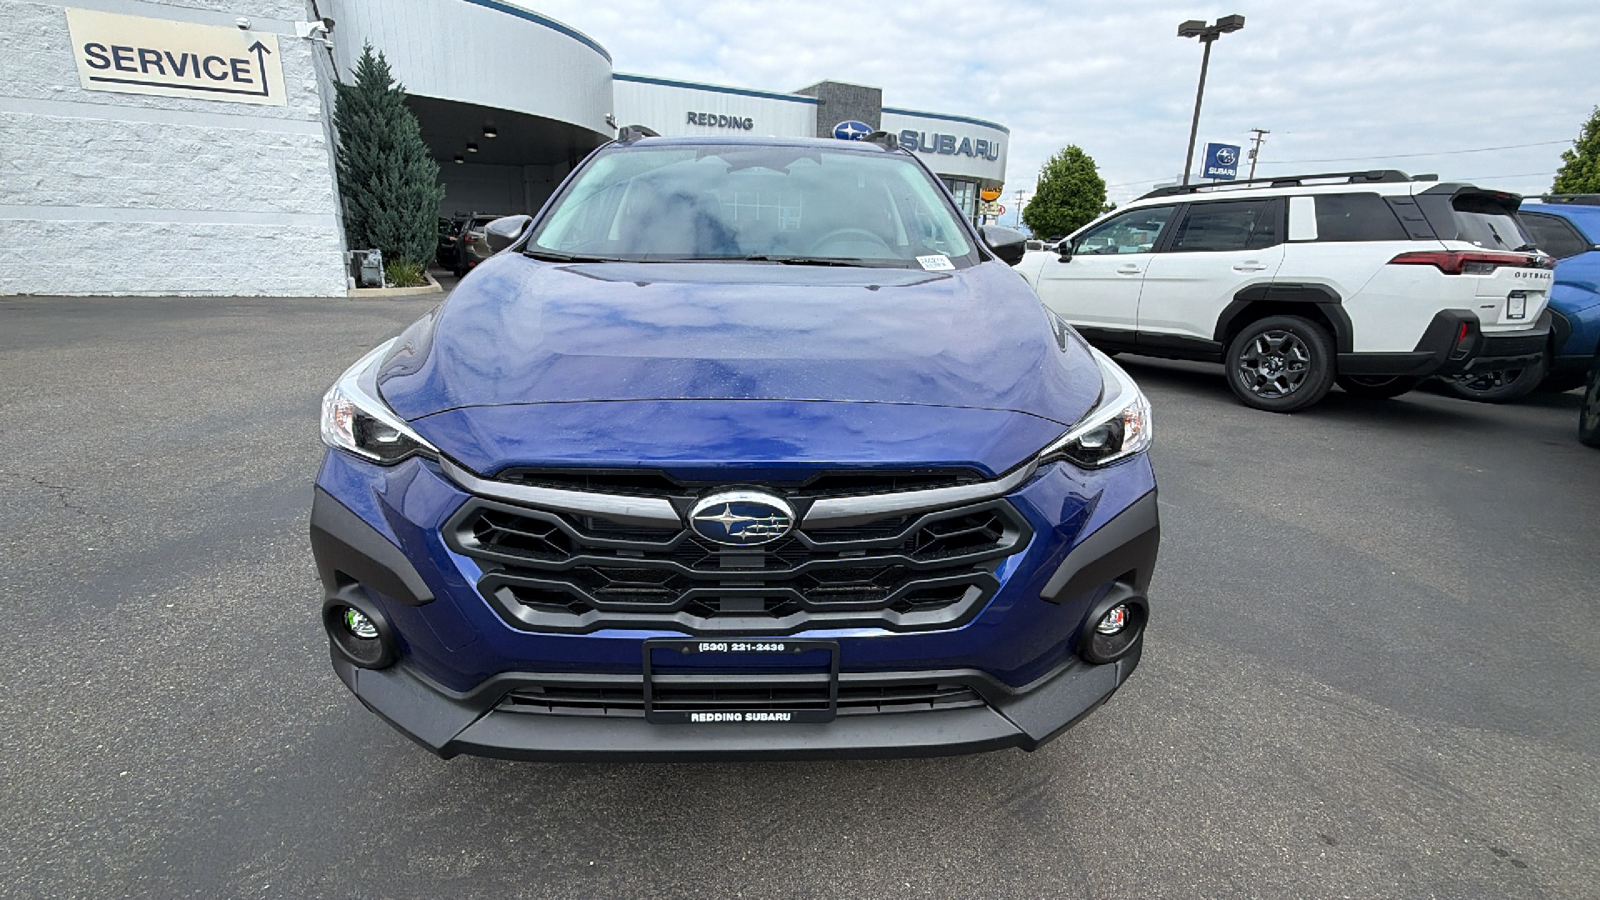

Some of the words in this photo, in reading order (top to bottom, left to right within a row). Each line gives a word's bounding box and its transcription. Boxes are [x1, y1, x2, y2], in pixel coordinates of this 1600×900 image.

[84, 43, 253, 84] SERVICE
[687, 111, 754, 130] REDDING
[898, 129, 1000, 161] SUBARU
[1208, 167, 1236, 177] SUBARU
[1514, 271, 1551, 280] OUTBACK
[698, 643, 728, 653] (530)
[731, 643, 785, 652] 221-2436
[691, 712, 743, 722] REDDING
[745, 712, 791, 721] SUBARU
